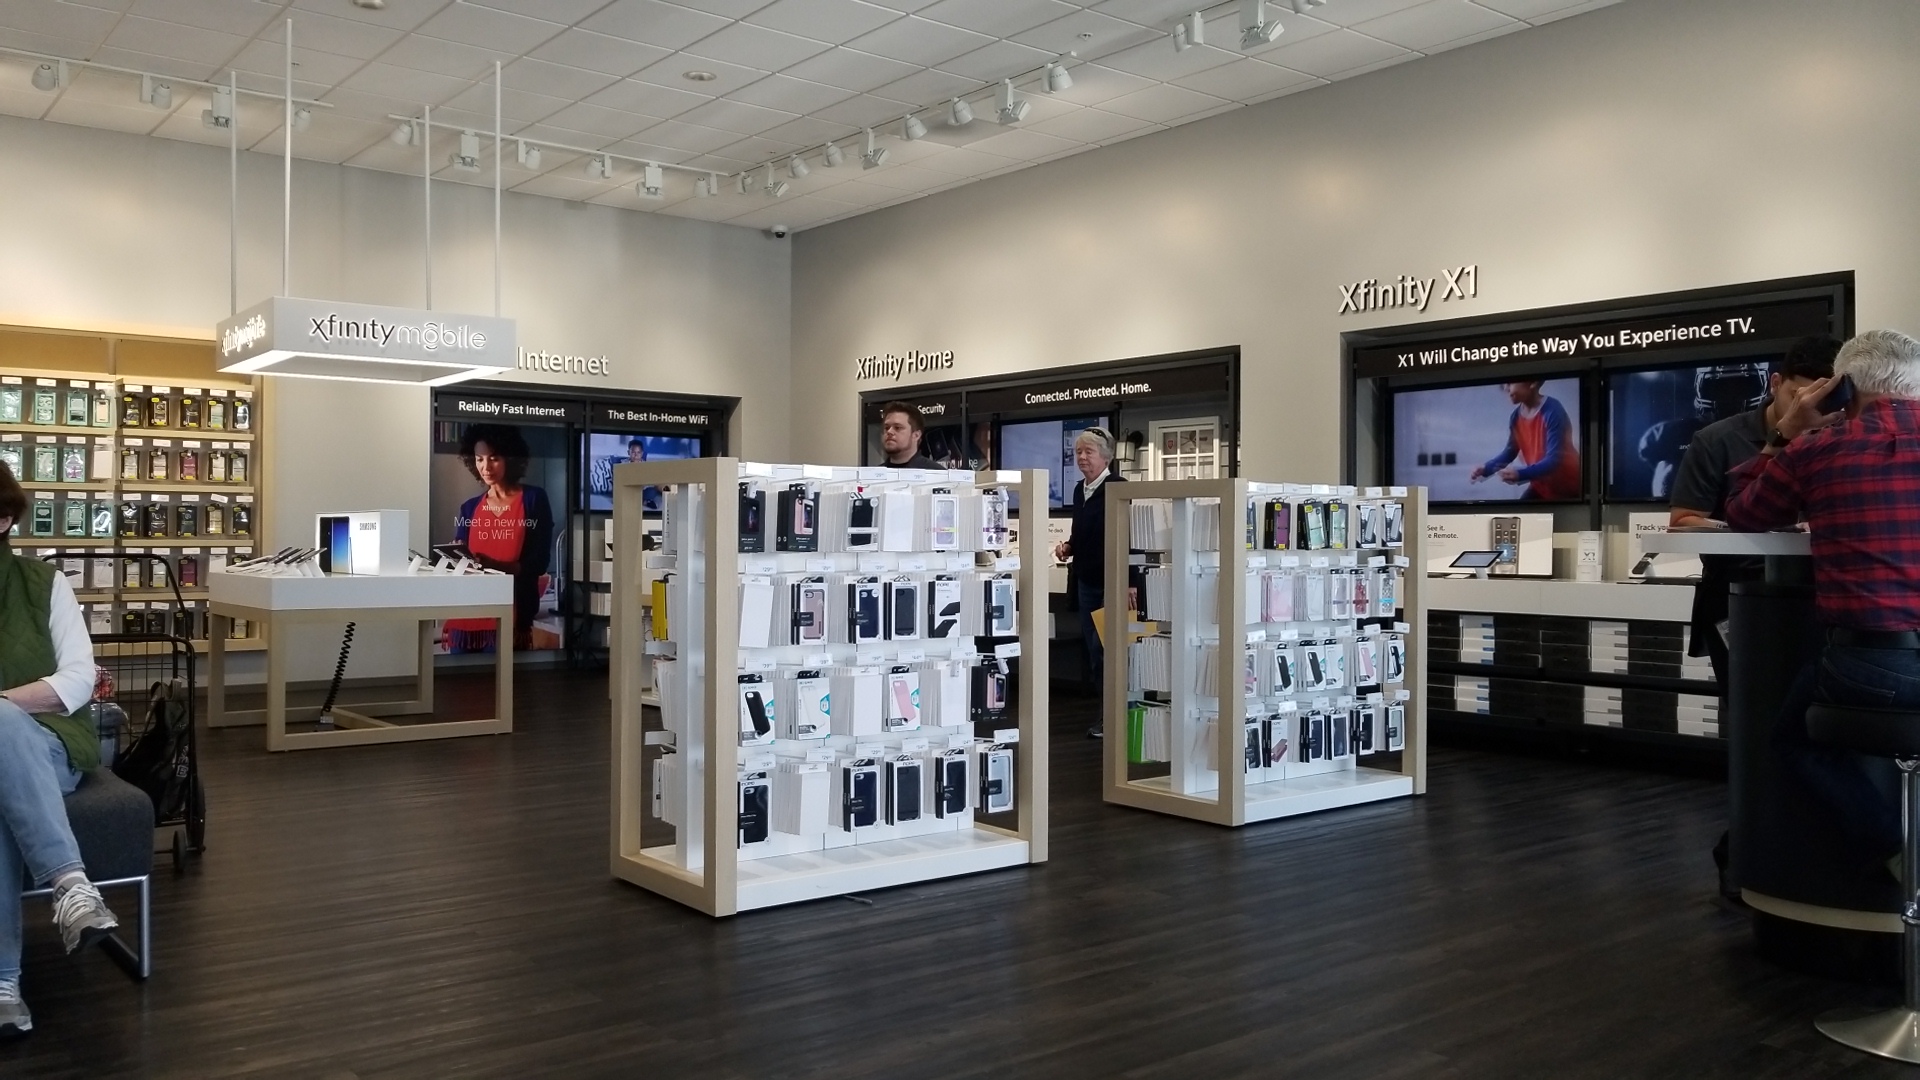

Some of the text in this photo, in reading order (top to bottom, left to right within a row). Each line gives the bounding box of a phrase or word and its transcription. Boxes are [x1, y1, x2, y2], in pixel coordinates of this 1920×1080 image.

[1338, 264, 1478, 313] Xfinity X1
[1398, 317, 1756, 368] X1 Will Change the Way You Experience TV.
[516, 346, 610, 376] Internet
[856, 349, 954, 381] Xfinity Home
[1025, 382, 1152, 404] Connected. Protected. Home.
[458, 401, 566, 417] Reliably Fast Internet
[917, 403, 946, 415] Security
[607, 410, 709, 425] The Best In-Home WiFi
[482, 505, 501, 513] Xfinity
[453, 516, 539, 530] Meet a new way
[1635, 523, 1656, 531] Track
[478, 529, 515, 540] to WiFi
